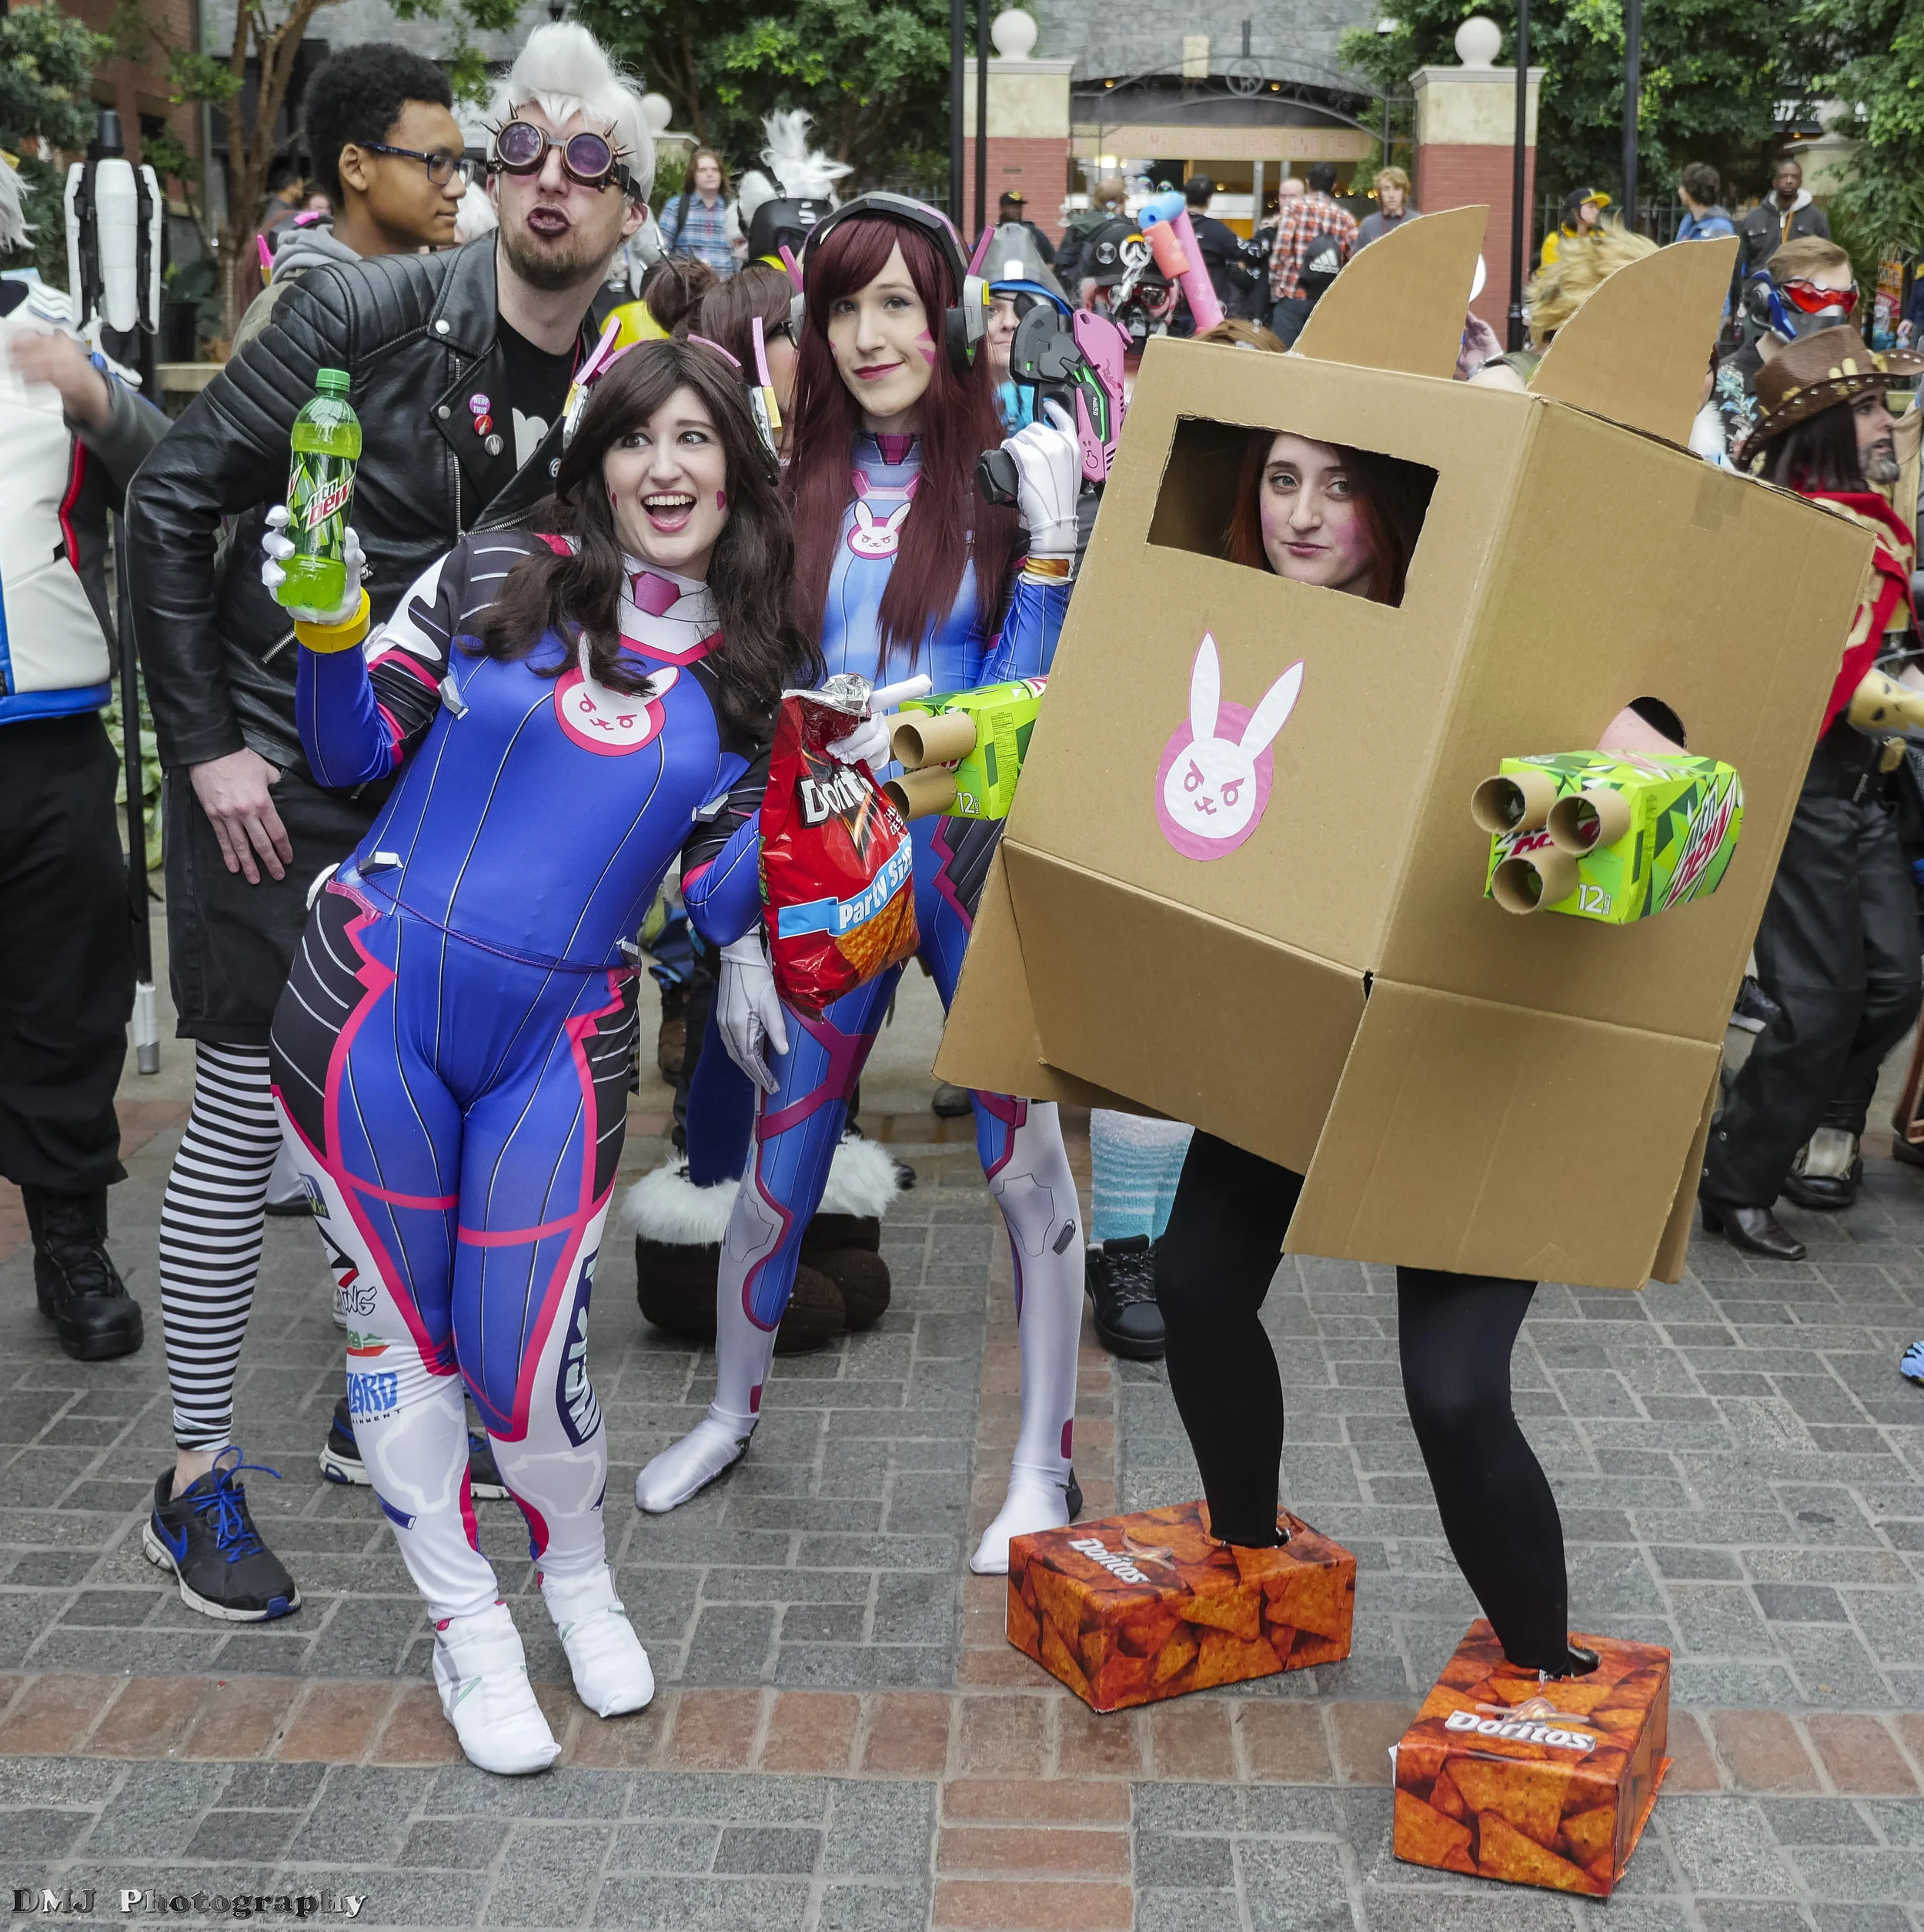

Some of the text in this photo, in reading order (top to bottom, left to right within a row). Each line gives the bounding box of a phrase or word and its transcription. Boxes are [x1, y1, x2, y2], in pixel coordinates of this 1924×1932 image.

[473, 397, 488, 405] NERF
[473, 405, 487, 414] THIS
[800, 766, 875, 823] Dorit
[957, 792, 975, 814] 12
[839, 874, 887, 929] Party
[1578, 883, 1604, 913] 12
[1067, 1537, 1151, 1584] Doritos
[1445, 1710, 1596, 1753] Doritos
